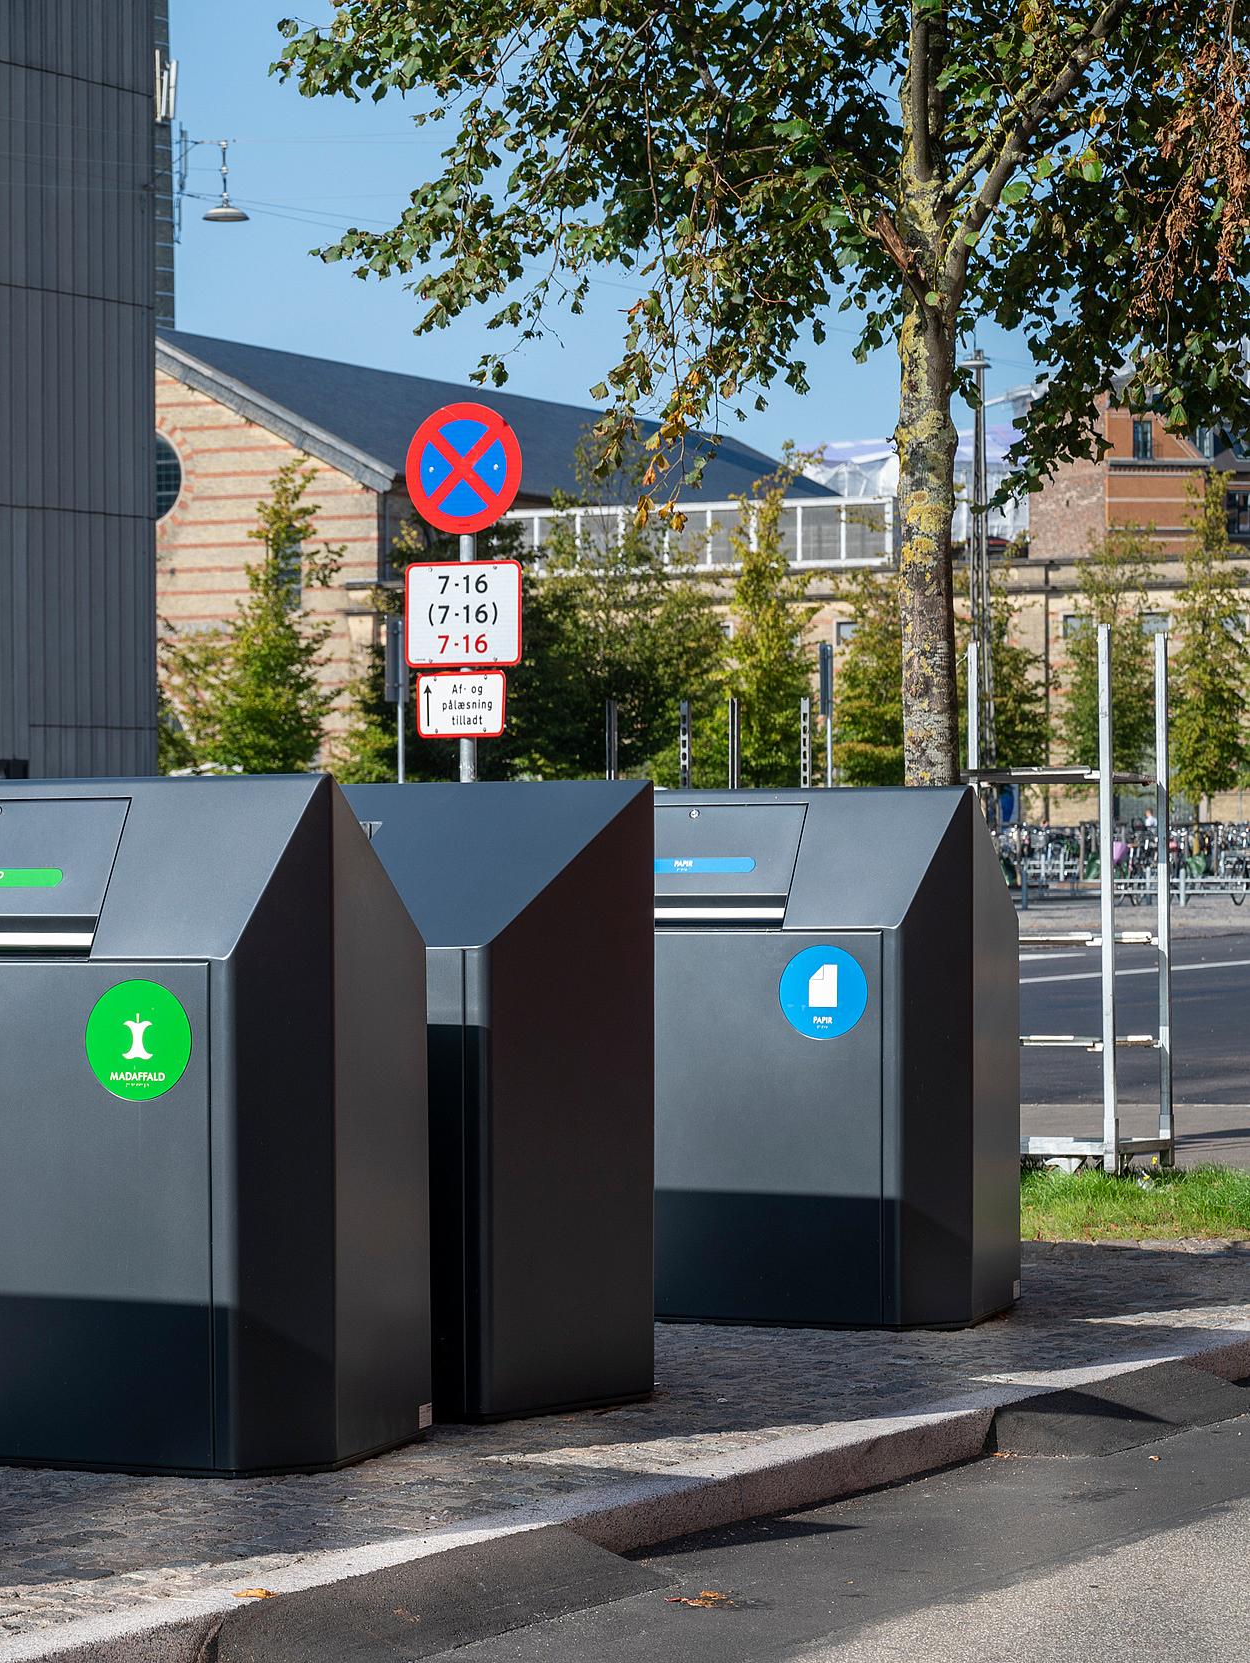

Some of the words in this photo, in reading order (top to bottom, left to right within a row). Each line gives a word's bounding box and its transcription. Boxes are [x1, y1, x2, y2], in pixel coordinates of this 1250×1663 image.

[438, 574, 488, 594] 7-16
[429, 602, 498, 626] (7-16)
[438, 634, 488, 654] 7-16
[452, 684, 466, 694] Af-
[471, 686, 483, 695] og
[442, 699, 493, 712] pålæsning
[452, 715, 483, 725] tilladt
[673, 860, 694, 868] PAPIR
[813, 1016, 833, 1024] PAPIR
[110, 1072, 166, 1082] MADAFFALD
